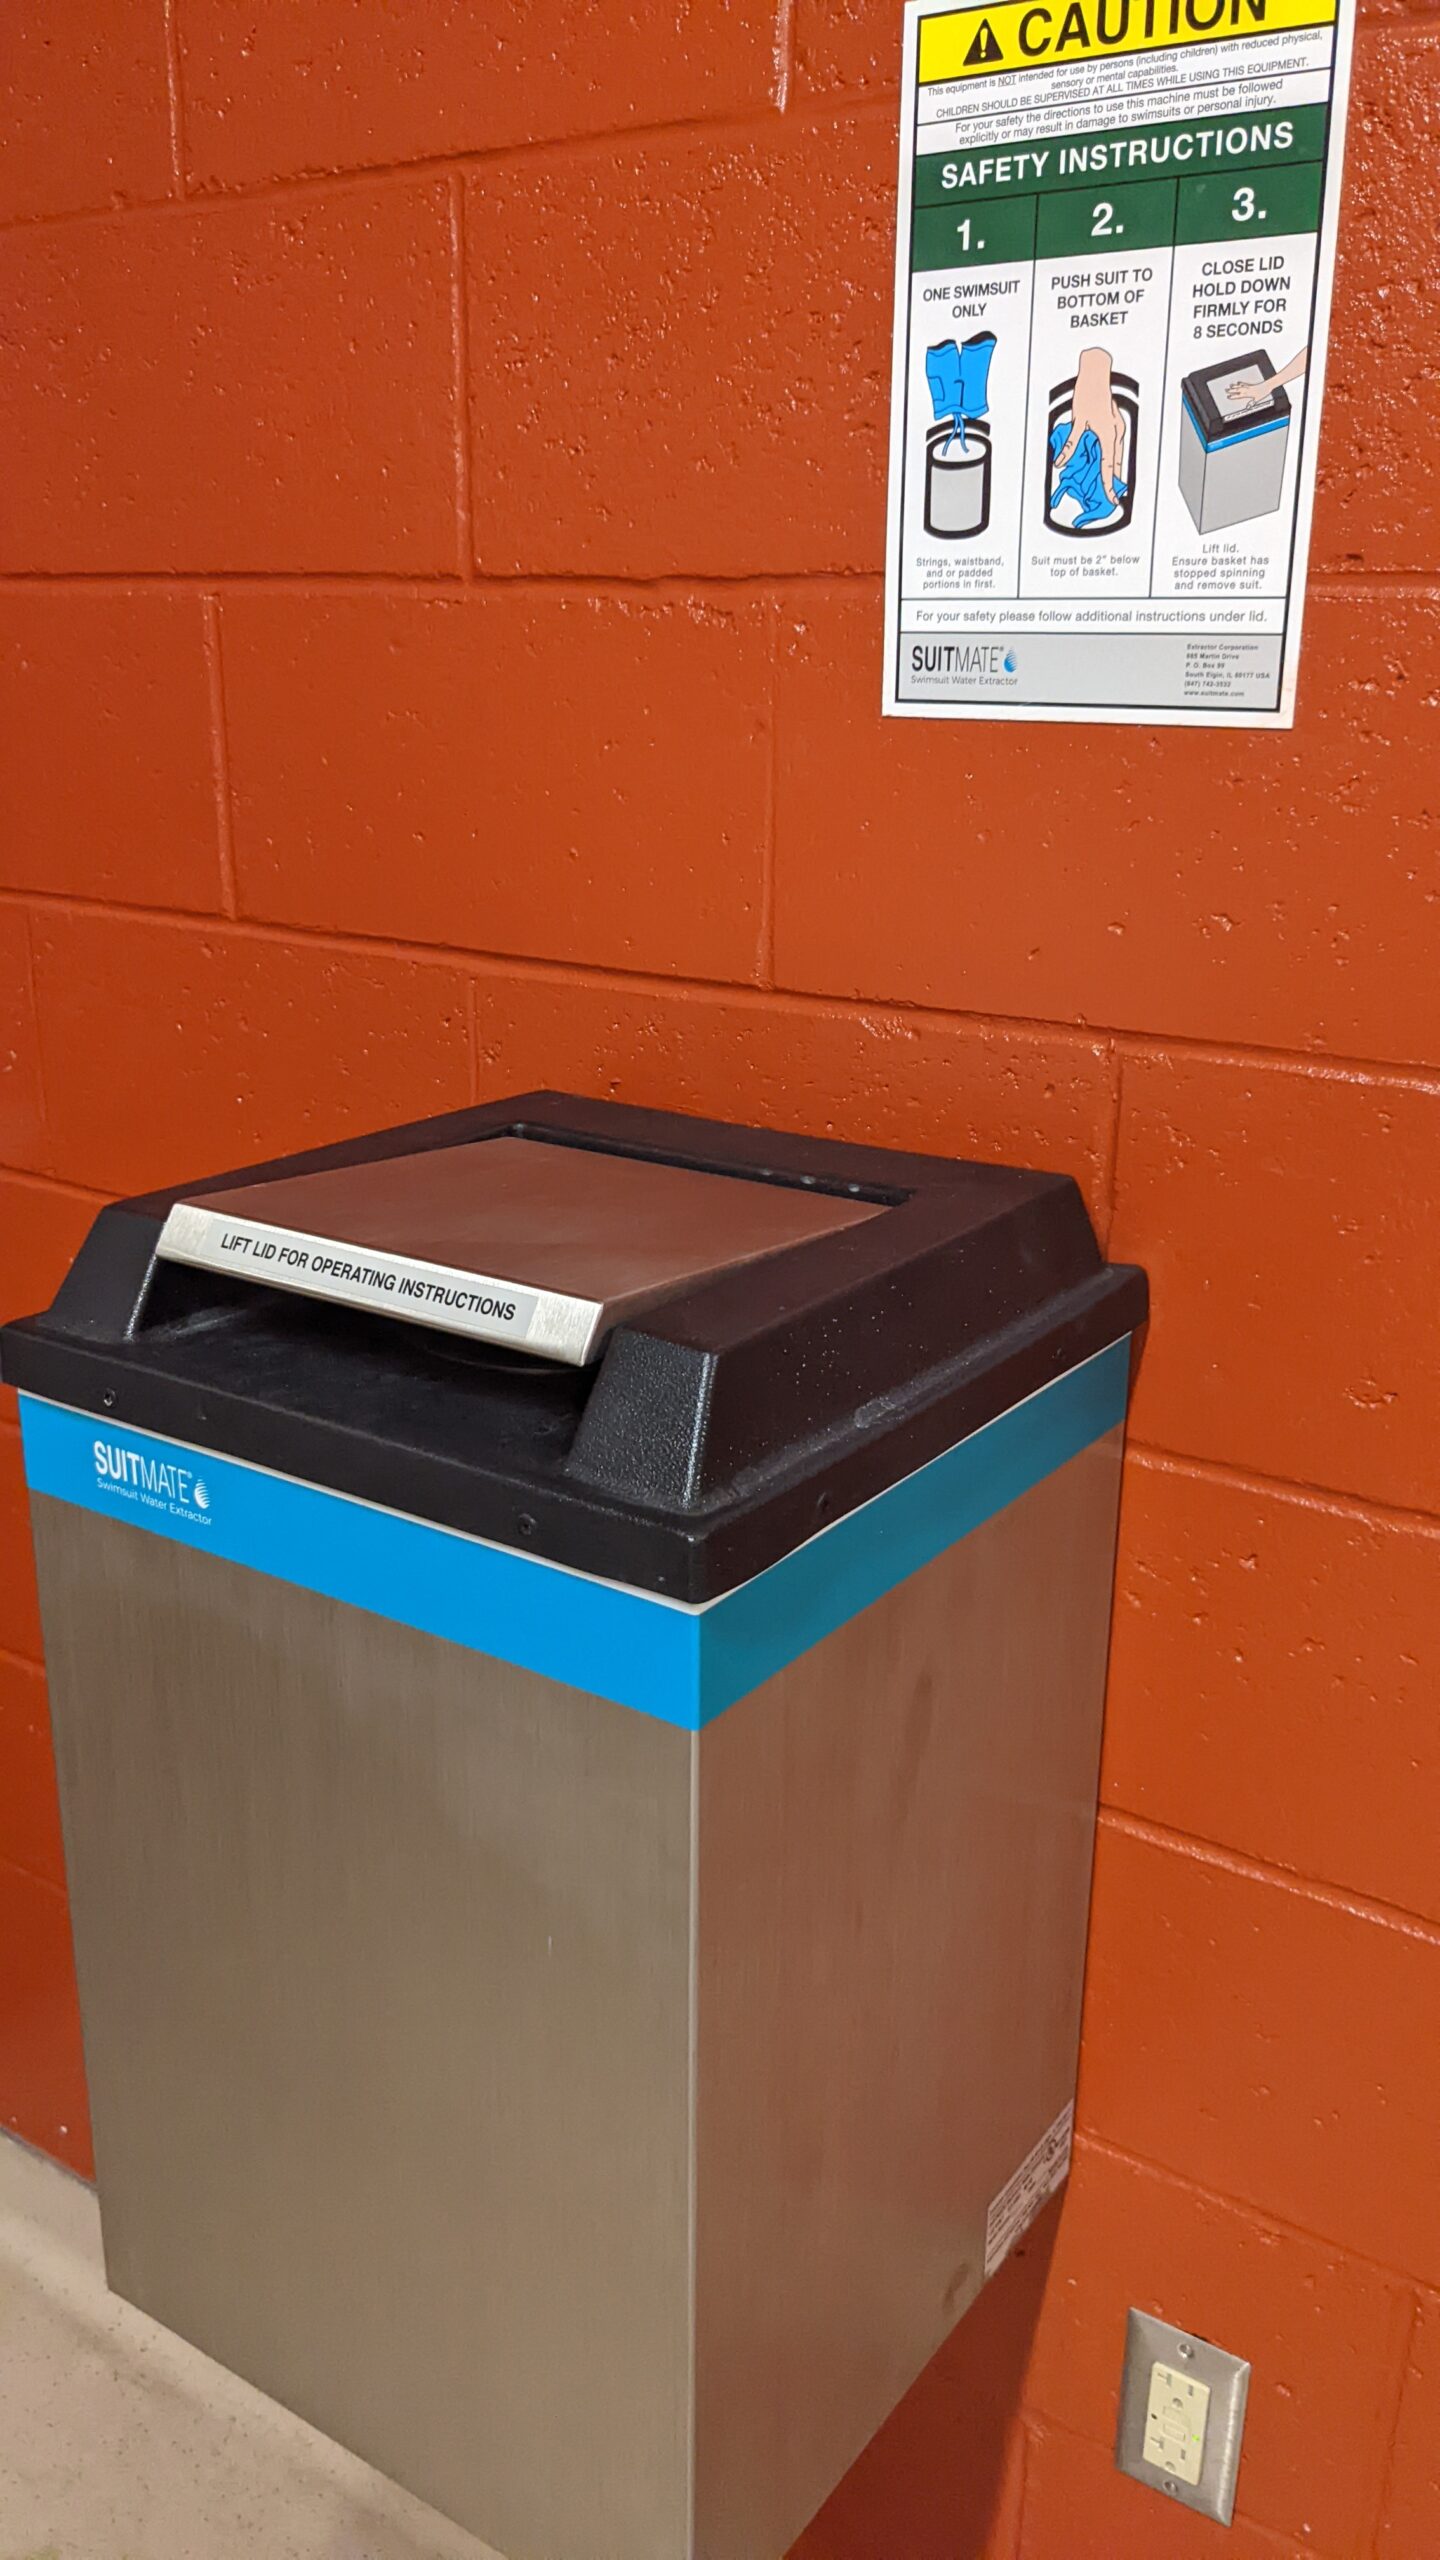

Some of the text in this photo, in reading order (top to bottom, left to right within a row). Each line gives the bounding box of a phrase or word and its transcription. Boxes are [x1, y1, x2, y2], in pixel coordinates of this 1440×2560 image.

[928, 30, 1323, 96] This equipment is NOT intended for use by persons (including children) with reduced physical,
[1051, 63, 1179, 90] sensory or mental capabilities.
[936, 57, 1309, 118] CHILDREN SHOULD BE SUPERVISED AT ALL TIMES WHILE USING THIS EQUIPMENT.
[956, 78, 1283, 134] For your safety the directions to use this machine must be followed
[959, 94, 1276, 146] explicitly or may result in damage to swimsuits or personal injury.
[941, 120, 1294, 190] SAFETY INSTRUCTIONS
[1231, 186, 1267, 222] 3.
[1090, 202, 1124, 237] 2.
[956, 219, 985, 251] 1.
[1202, 255, 1285, 276] CLOSE LID
[1051, 267, 1153, 291] PUSH SUIT TO
[1192, 276, 1291, 298] HOLD DOWN
[922, 279, 1021, 302] ONE SWIMSUIT
[1057, 289, 1145, 309] BOTTOM OF
[952, 303, 987, 319] ONLY
[1193, 298, 1287, 319] FIRMLY FOR
[1070, 311, 1129, 329] BASKET
[1193, 319, 1283, 339] 8 SECONDS
[1202, 543, 1240, 554] Lift lid.
[916, 556, 1004, 569] Strings, waistband,
[1031, 555, 1050, 566] Suit
[1054, 556, 1077, 566] must
[1080, 555, 1093, 565] be
[1110, 554, 1140, 565] below
[1172, 555, 1269, 566] Ensure basket has
[926, 568, 993, 580] and or padded
[1050, 567, 1118, 578] top of basket.
[1174, 567, 1265, 580] stopped spinning
[923, 579, 996, 591] portions in first.
[1174, 580, 1262, 590] and remove suit.
[916, 609, 1268, 625] For your safety please follow additional instructions under lid.
[1186, 643, 1259, 652] Extractor Corporation
[911, 645, 998, 673] SUITMATE
[911, 674, 1018, 686] Swimsuit Water Extractor
[220, 1233, 516, 1321] LIFT LID FOR OPERATING INSTRUCTIONS
[93, 1440, 190, 1504] SUITMATE
[96, 1477, 213, 1526] Swimsuit Water Extractor
